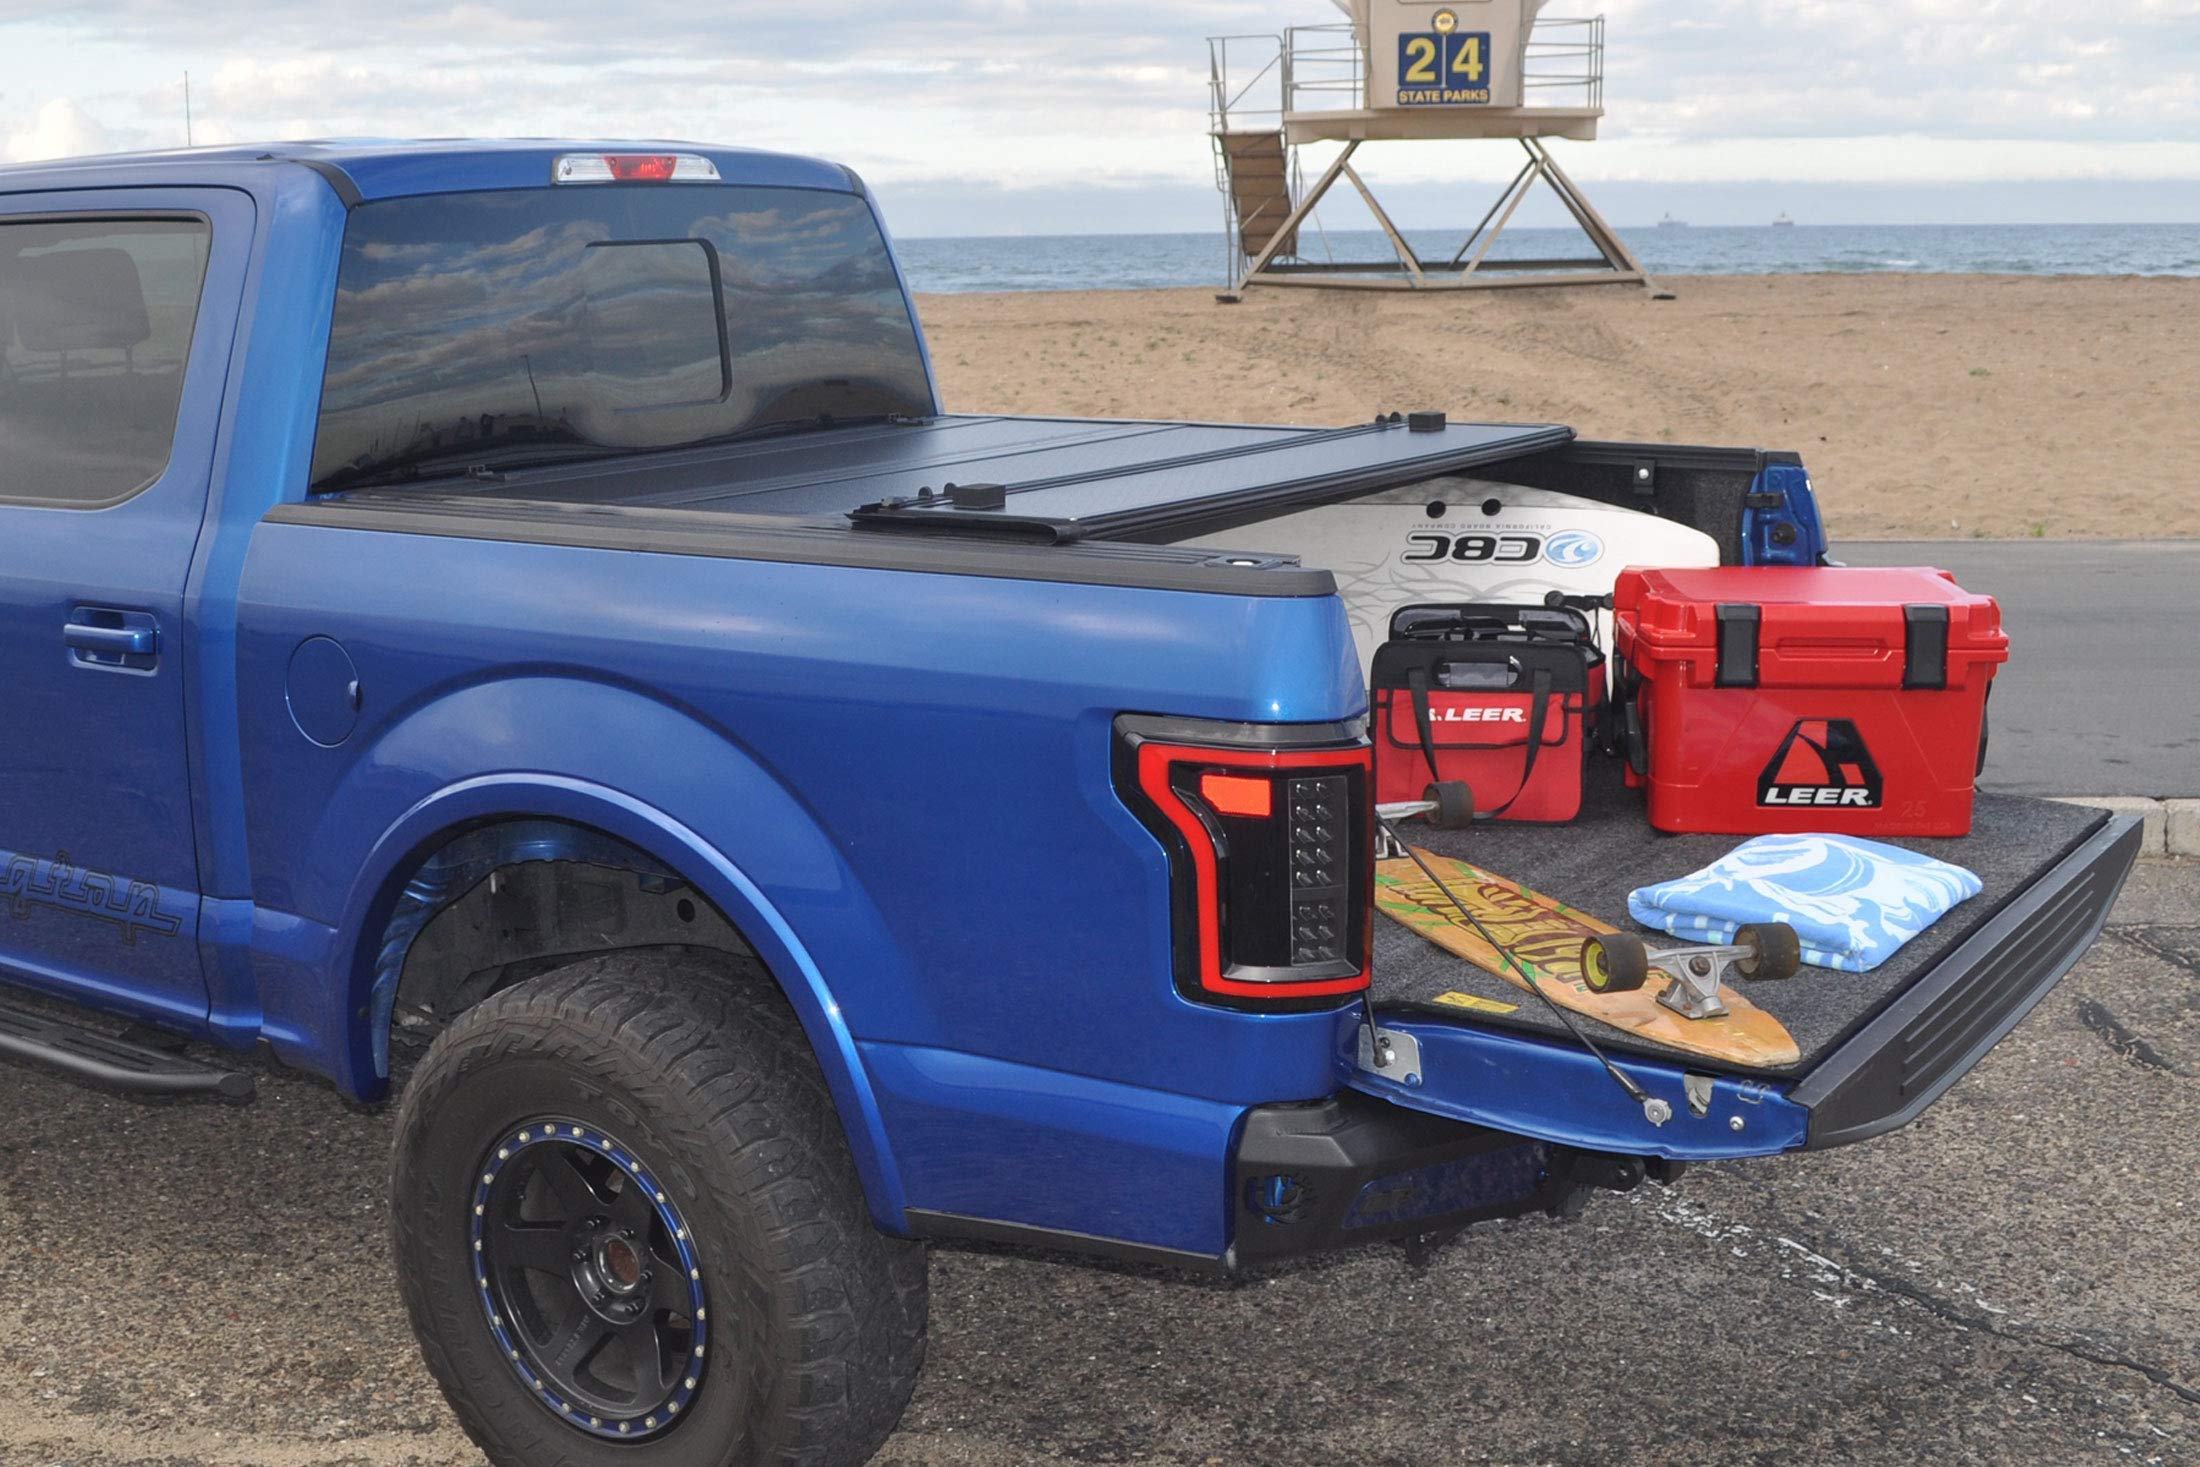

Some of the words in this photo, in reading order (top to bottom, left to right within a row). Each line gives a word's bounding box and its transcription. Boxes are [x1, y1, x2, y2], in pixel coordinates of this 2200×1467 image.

[1399, 90, 1440, 102] STATE
[1443, 89, 1488, 102] PARKS
[1405, 536, 1541, 562] CBC
[1445, 707, 1524, 723] LEER
[1764, 787, 1869, 806] LEER
